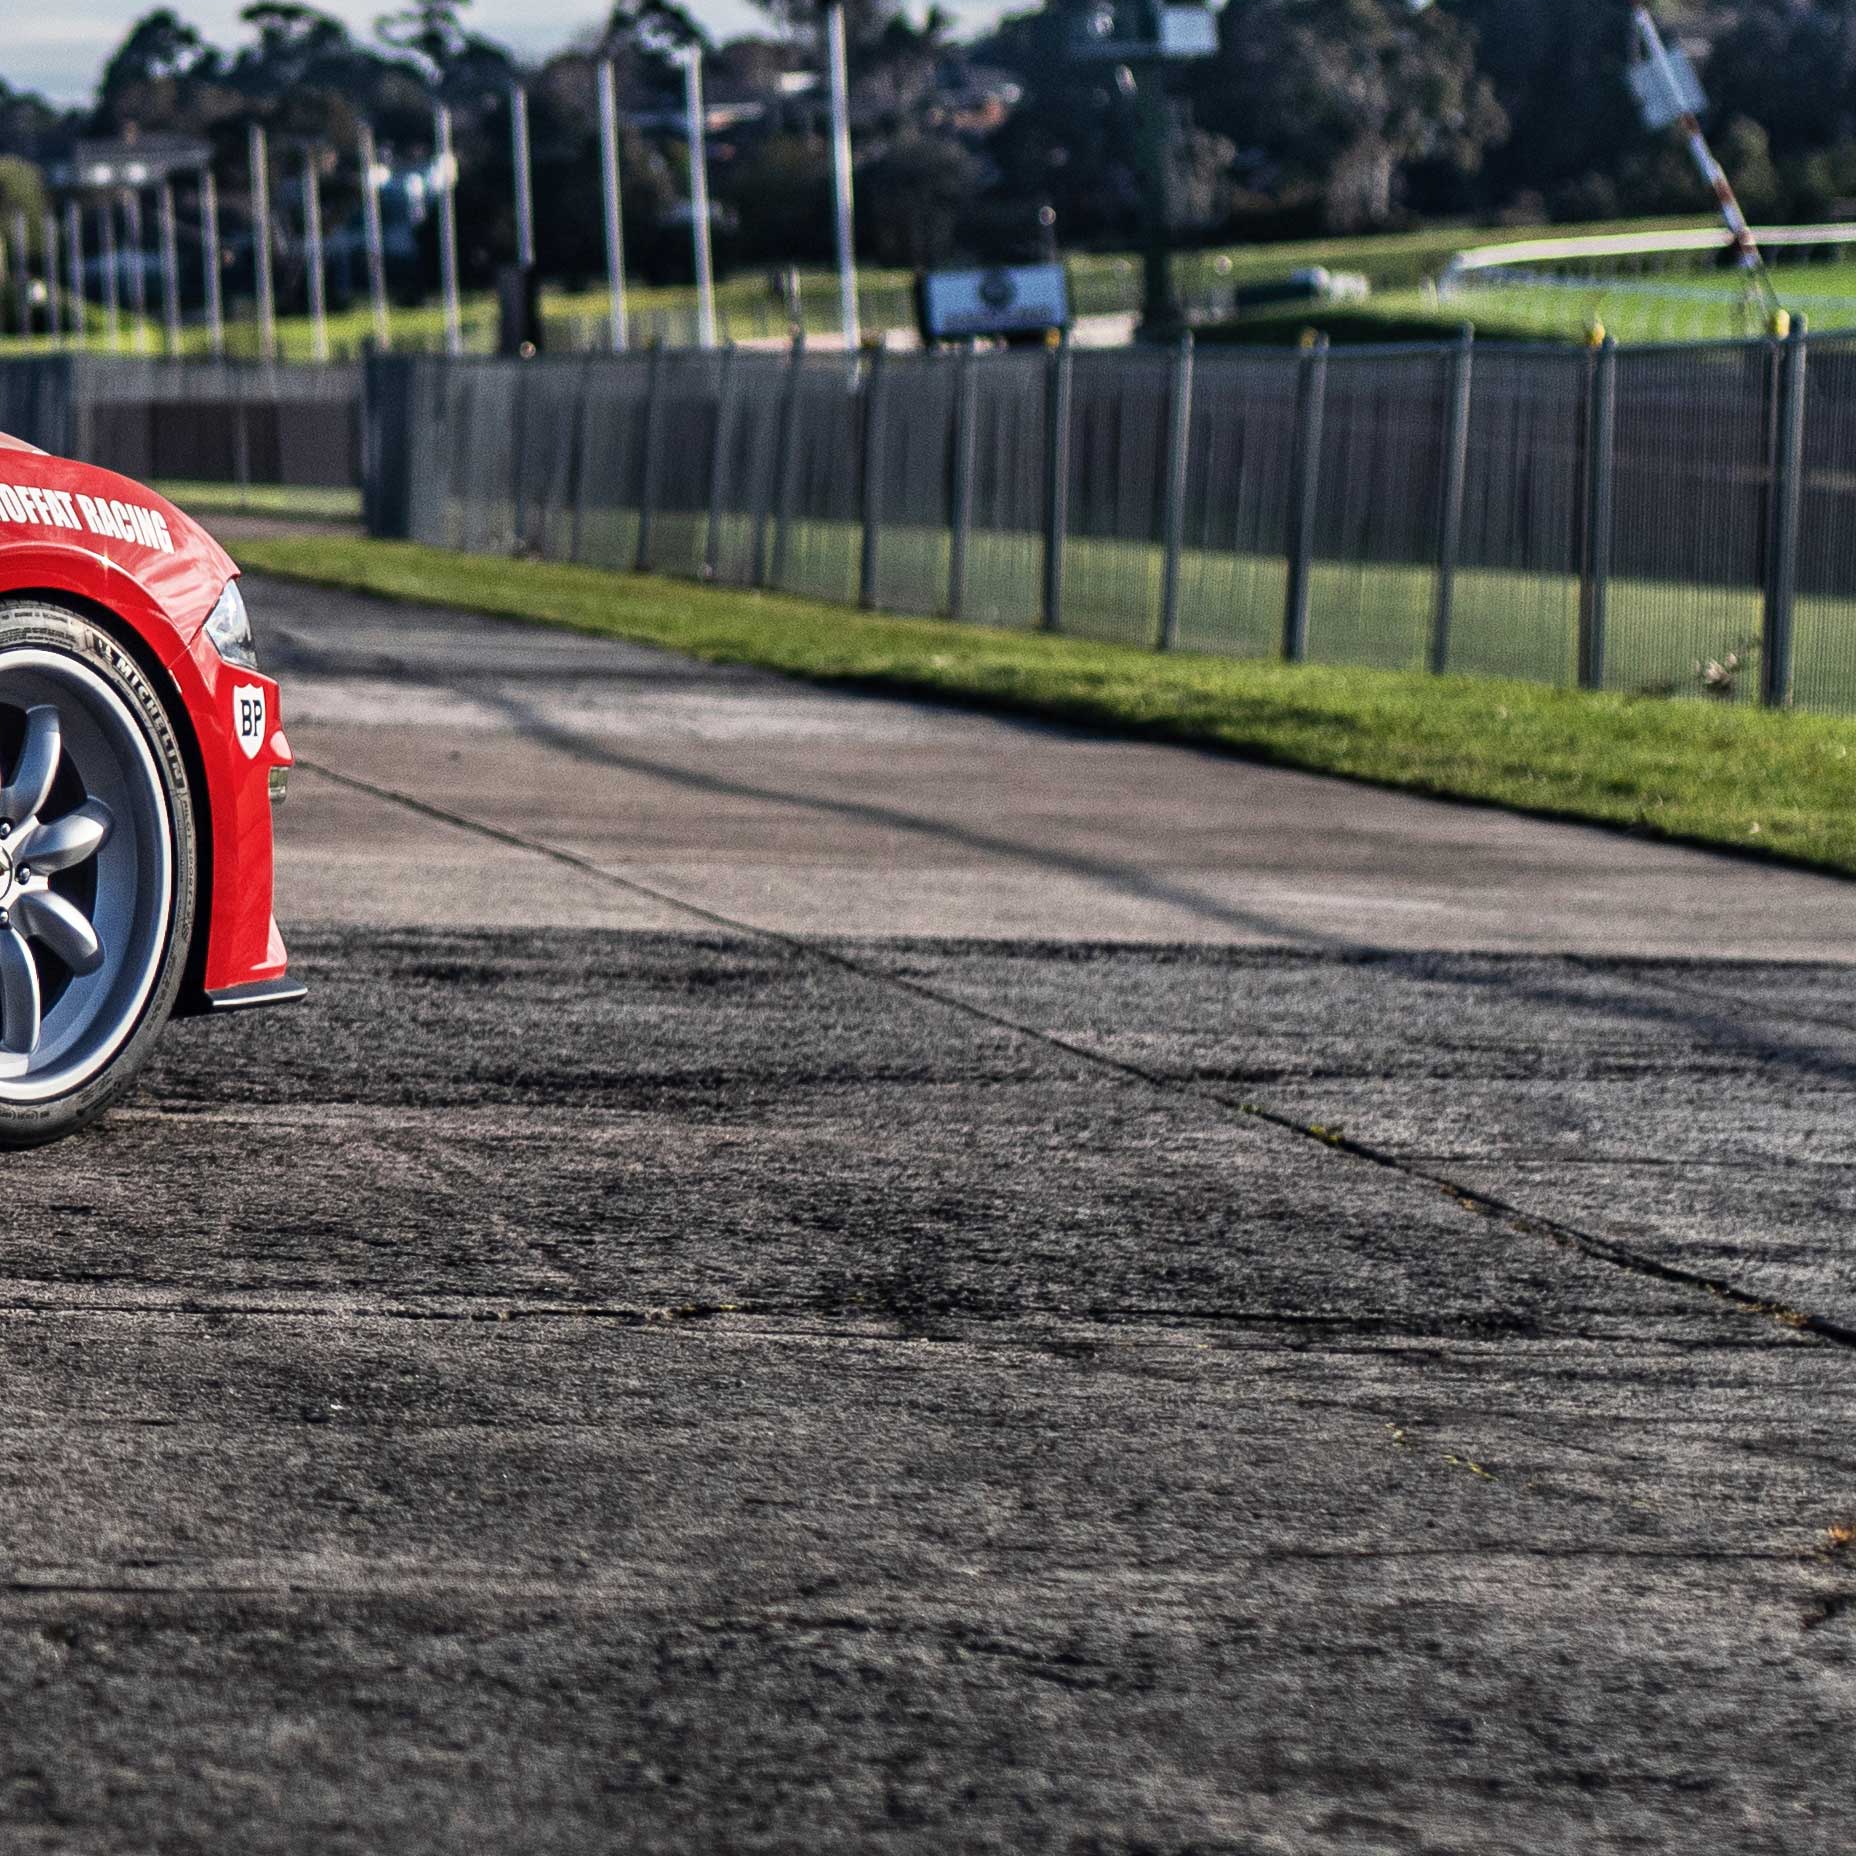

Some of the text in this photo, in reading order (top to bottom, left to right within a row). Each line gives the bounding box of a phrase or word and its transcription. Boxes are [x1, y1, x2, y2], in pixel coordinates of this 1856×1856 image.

[75, 494, 175, 554] RACING
[116, 654, 183, 781] MICHELIN
[240, 699, 263, 736] BP
